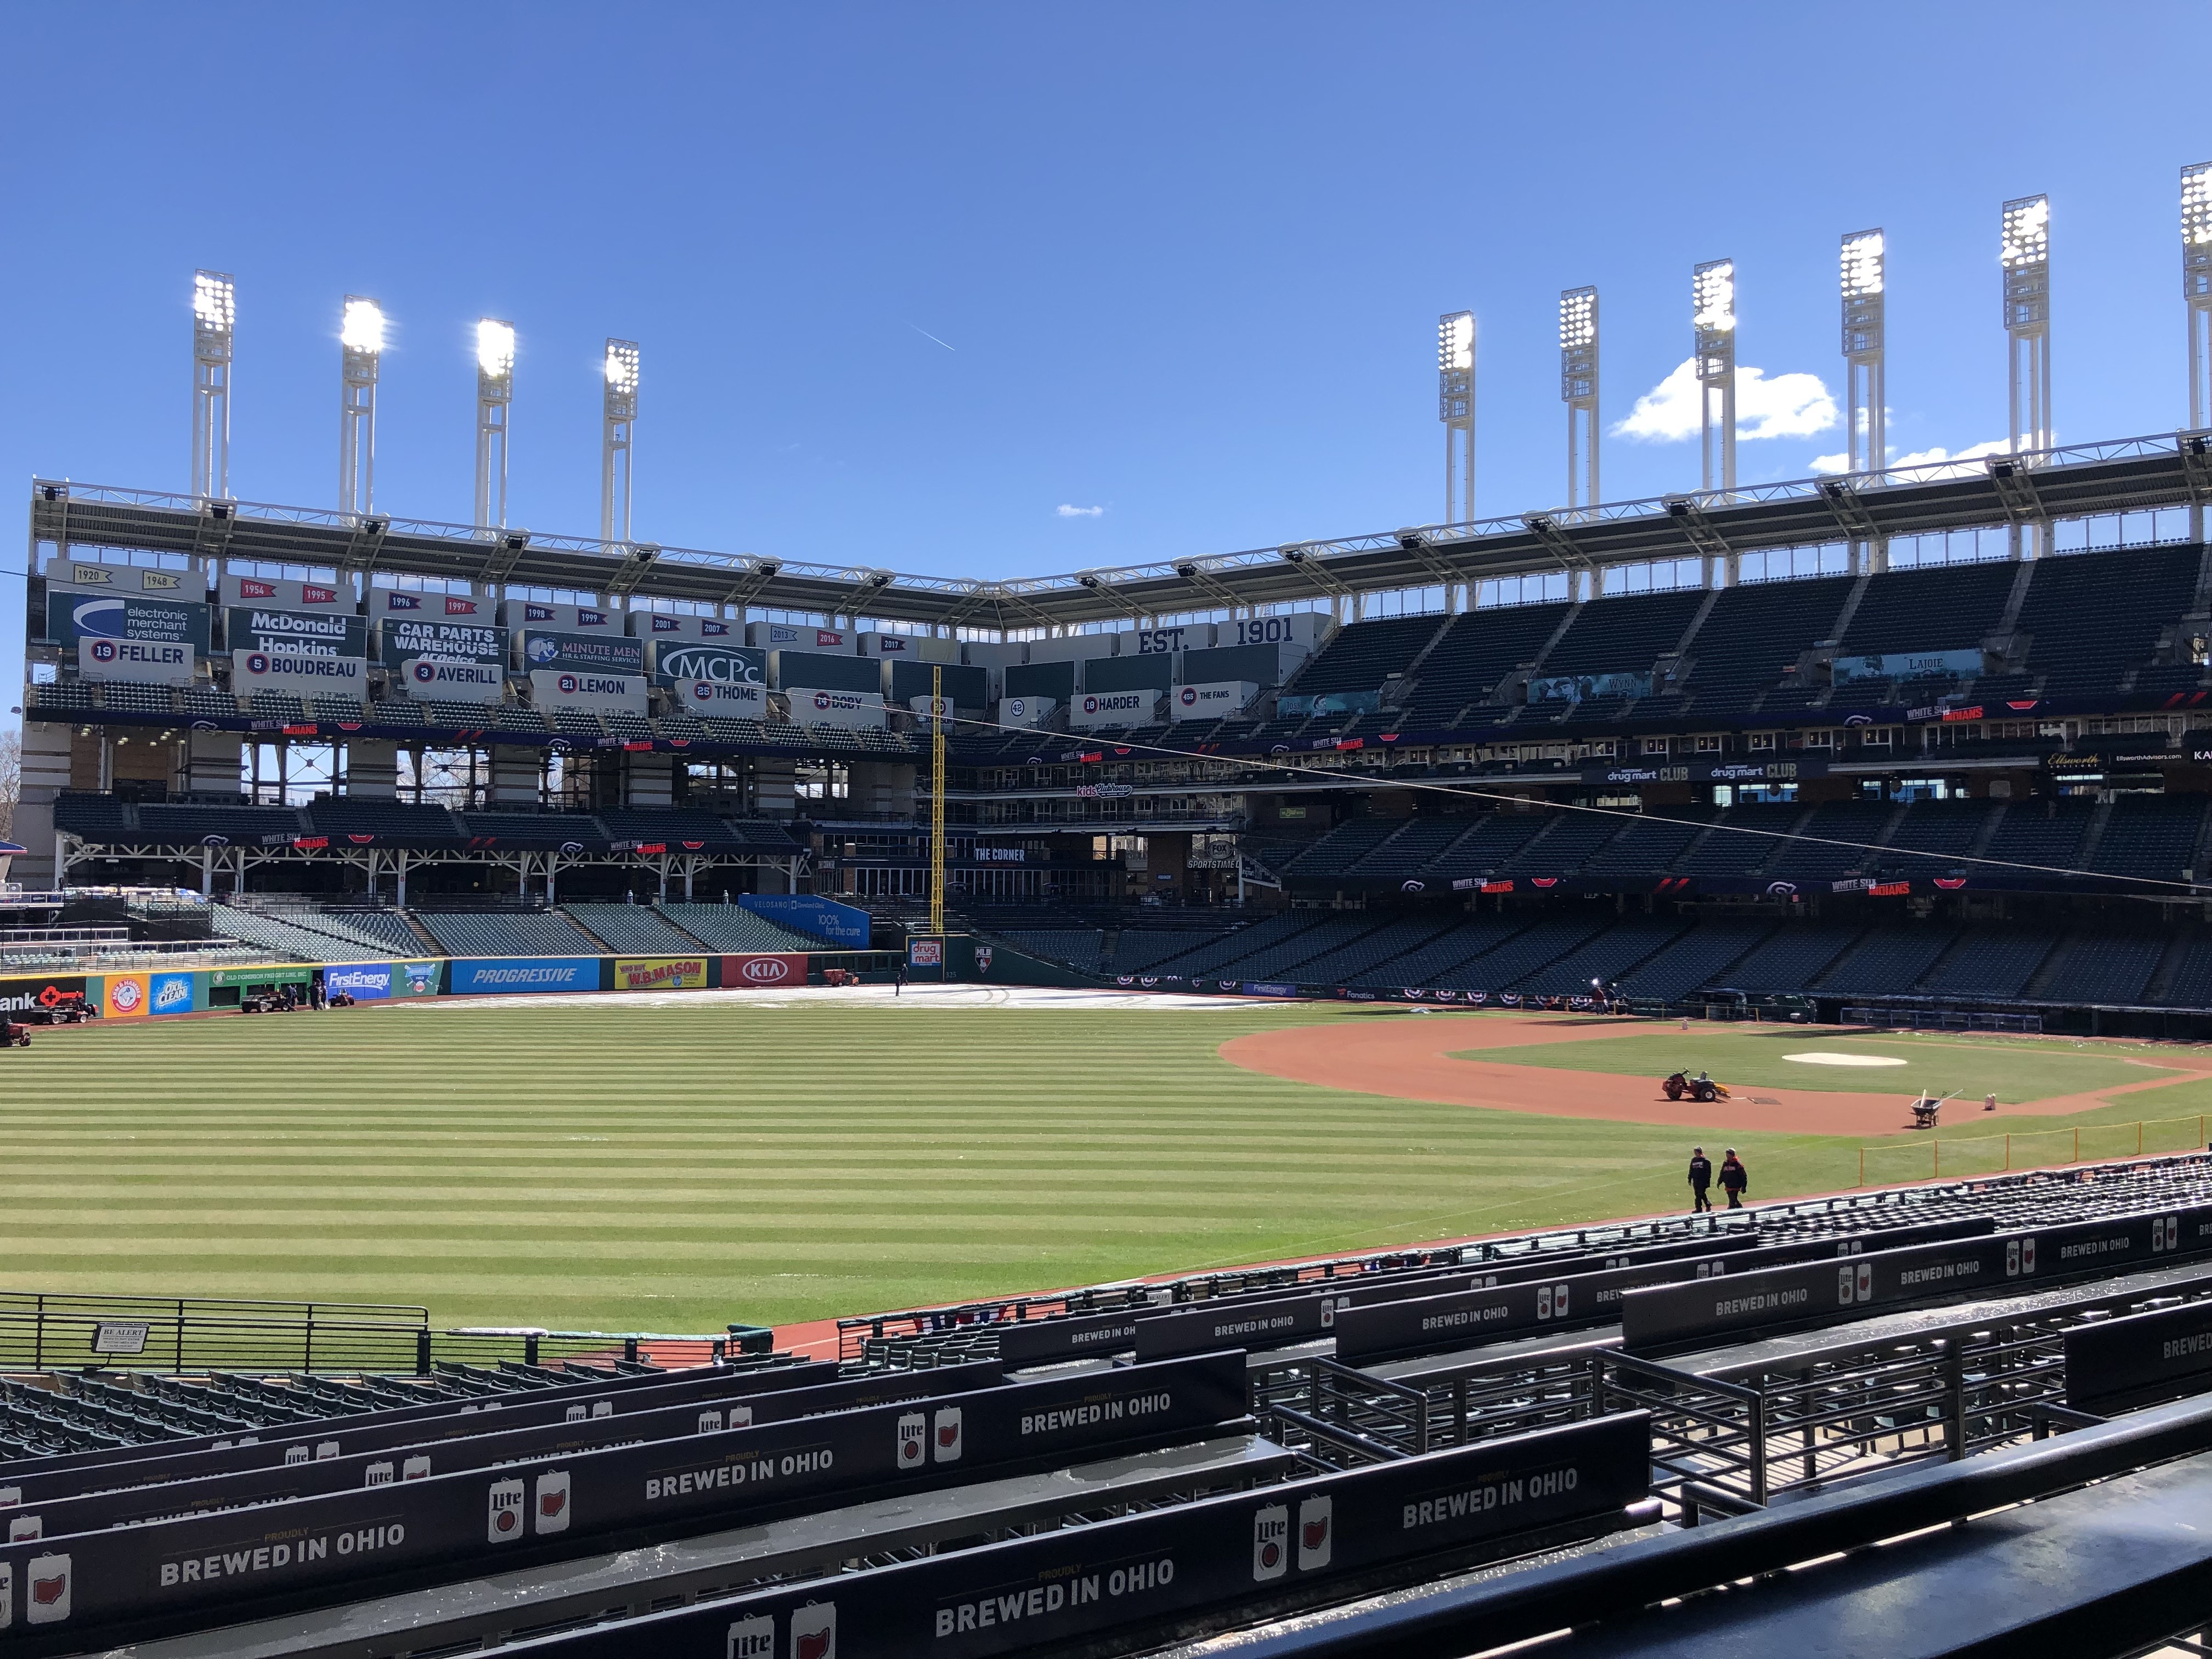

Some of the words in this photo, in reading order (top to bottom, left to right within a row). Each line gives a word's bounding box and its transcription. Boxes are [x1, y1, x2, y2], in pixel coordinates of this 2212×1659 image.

[78, 570, 99, 580] 1920
[147, 576, 167, 586] 1948
[245, 584, 264, 595] 1954
[307, 590, 325, 600] 1995
[393, 597, 410, 607] 1996
[449, 601, 465, 611] 1997
[128, 607, 188, 620] electronic
[528, 608, 545, 618] 1998
[582, 613, 597, 623] 1999
[128, 618, 187, 631] merchant
[251, 612, 346, 634] McDonald
[655, 619, 670, 629] 2001
[704, 624, 720, 633] 2007
[127, 629, 180, 641] systems
[399, 623, 434, 637] CAR
[440, 626, 494, 642] PARTS
[774, 630, 788, 639] 2013
[1237, 617, 1293, 645] 1901
[820, 634, 834, 643] 2016
[884, 640, 898, 649] 2017
[1139, 628, 1189, 654] EST.
[394, 636, 499, 656] WAREHOUSE
[562, 642, 610, 655] MINUTE
[613, 646, 640, 658] MEN
[96, 646, 111, 657] 19
[120, 645, 184, 664] FELLER
[254, 659, 262, 669] 5
[272, 658, 356, 678] BOUDREAU
[1909, 658, 1943, 669] LAJOIE
[421, 668, 428, 677] 3
[437, 667, 496, 684] AVERILL
[562, 679, 573, 689] 21
[579, 678, 625, 695] LEMON
[1609, 678, 1637, 689] WYNN
[697, 686, 710, 696] 25
[714, 685, 758, 701] THOME
[1200, 691, 1211, 699] THE
[1212, 690, 1229, 699] FANS
[832, 696, 862, 710] DOBY
[1086, 701, 1095, 709] 18
[1099, 696, 1139, 710] HARDER
[1906, 707, 1932, 719] WHITE
[251, 720, 274, 729] WHITE
[1313, 739, 1330, 748] WHITE
[2048, 753, 2102, 765] Ellsworth
[1607, 771, 1631, 782] drug
[1632, 770, 1656, 780] mart
[1660, 767, 1689, 781] CLUB
[1711, 768, 1736, 780] drug
[1737, 766, 1763, 776] mart
[1767, 763, 1797, 778] CLUB
[1097, 783, 1131, 792] Clubhouse
[262, 834, 285, 843] WHITE
[975, 849, 990, 860] THE
[992, 849, 1024, 861] CORNER
[1188, 860, 1234, 868] SPORTSTIME
[1453, 879, 1472, 888] WHITE
[1832, 879, 1858, 890] WHITE
[819, 915, 839, 925] 100%
[826, 926, 835, 935] for
[836, 926, 845, 935] the
[913, 941, 936, 955] drug
[915, 954, 941, 962] mart
[472, 968, 577, 983] PROGRESSIVE
[751, 963, 780, 977] KIA
[329, 972, 390, 986] FirstEnergy
[166, 981, 182, 994] OXI
[1254, 985, 1286, 994] FirstEnergy
[159, 987, 187, 1005] CLEAN
[1347, 991, 1375, 999] Fanatics
[2061, 1242, 2097, 1259] BREWED
[2098, 1240, 2107, 1252] IN
[2109, 1237, 2129, 1250] OHIO
[1900, 1267, 1942, 1285] BREWED
[1944, 1265, 1954, 1278] IN
[1957, 1261, 1979, 1274] OHIO
[1716, 1295, 1764, 1316] BREWED
[1767, 1293, 1778, 1307] IN
[1781, 1288, 1807, 1304] OHIO
[1423, 1312, 1468, 1329] BREWED
[1469, 1310, 1481, 1322] IN
[1483, 1306, 1508, 1320] OHIO
[1215, 1321, 1257, 1336] BREWED
[1259, 1319, 1268, 1330] IN
[1271, 1316, 1294, 1327] OHIO
[1072, 1329, 1110, 1344] BREWED
[1112, 1328, 1121, 1338] IN
[2164, 1332, 2212, 1359] BREWED
[1022, 1405, 1100, 1435] BREWED
[1105, 1401, 1122, 1420] IN
[1128, 1393, 1171, 1415] OHIO
[900, 1424, 923, 1441] Lite
[646, 1464, 746, 1500] BREWED
[751, 1460, 774, 1481] IN
[781, 1450, 833, 1476] OHIO
[491, 1491, 522, 1511] Lite
[1403, 1487, 1497, 1528] BREWED
[1502, 1480, 1523, 1504] IN
[1530, 1468, 1578, 1498] OHIO
[1257, 1519, 1285, 1543] Lite
[161, 1543, 291, 1587] BREWED
[298, 1537, 327, 1562] IN
[337, 1524, 404, 1554] OHIO
[936, 1585, 1064, 1638] BREWED
[1071, 1576, 1098, 1605] IN
[1109, 1558, 1175, 1597] OHIO
[733, 1632, 771, 1658] Lite
